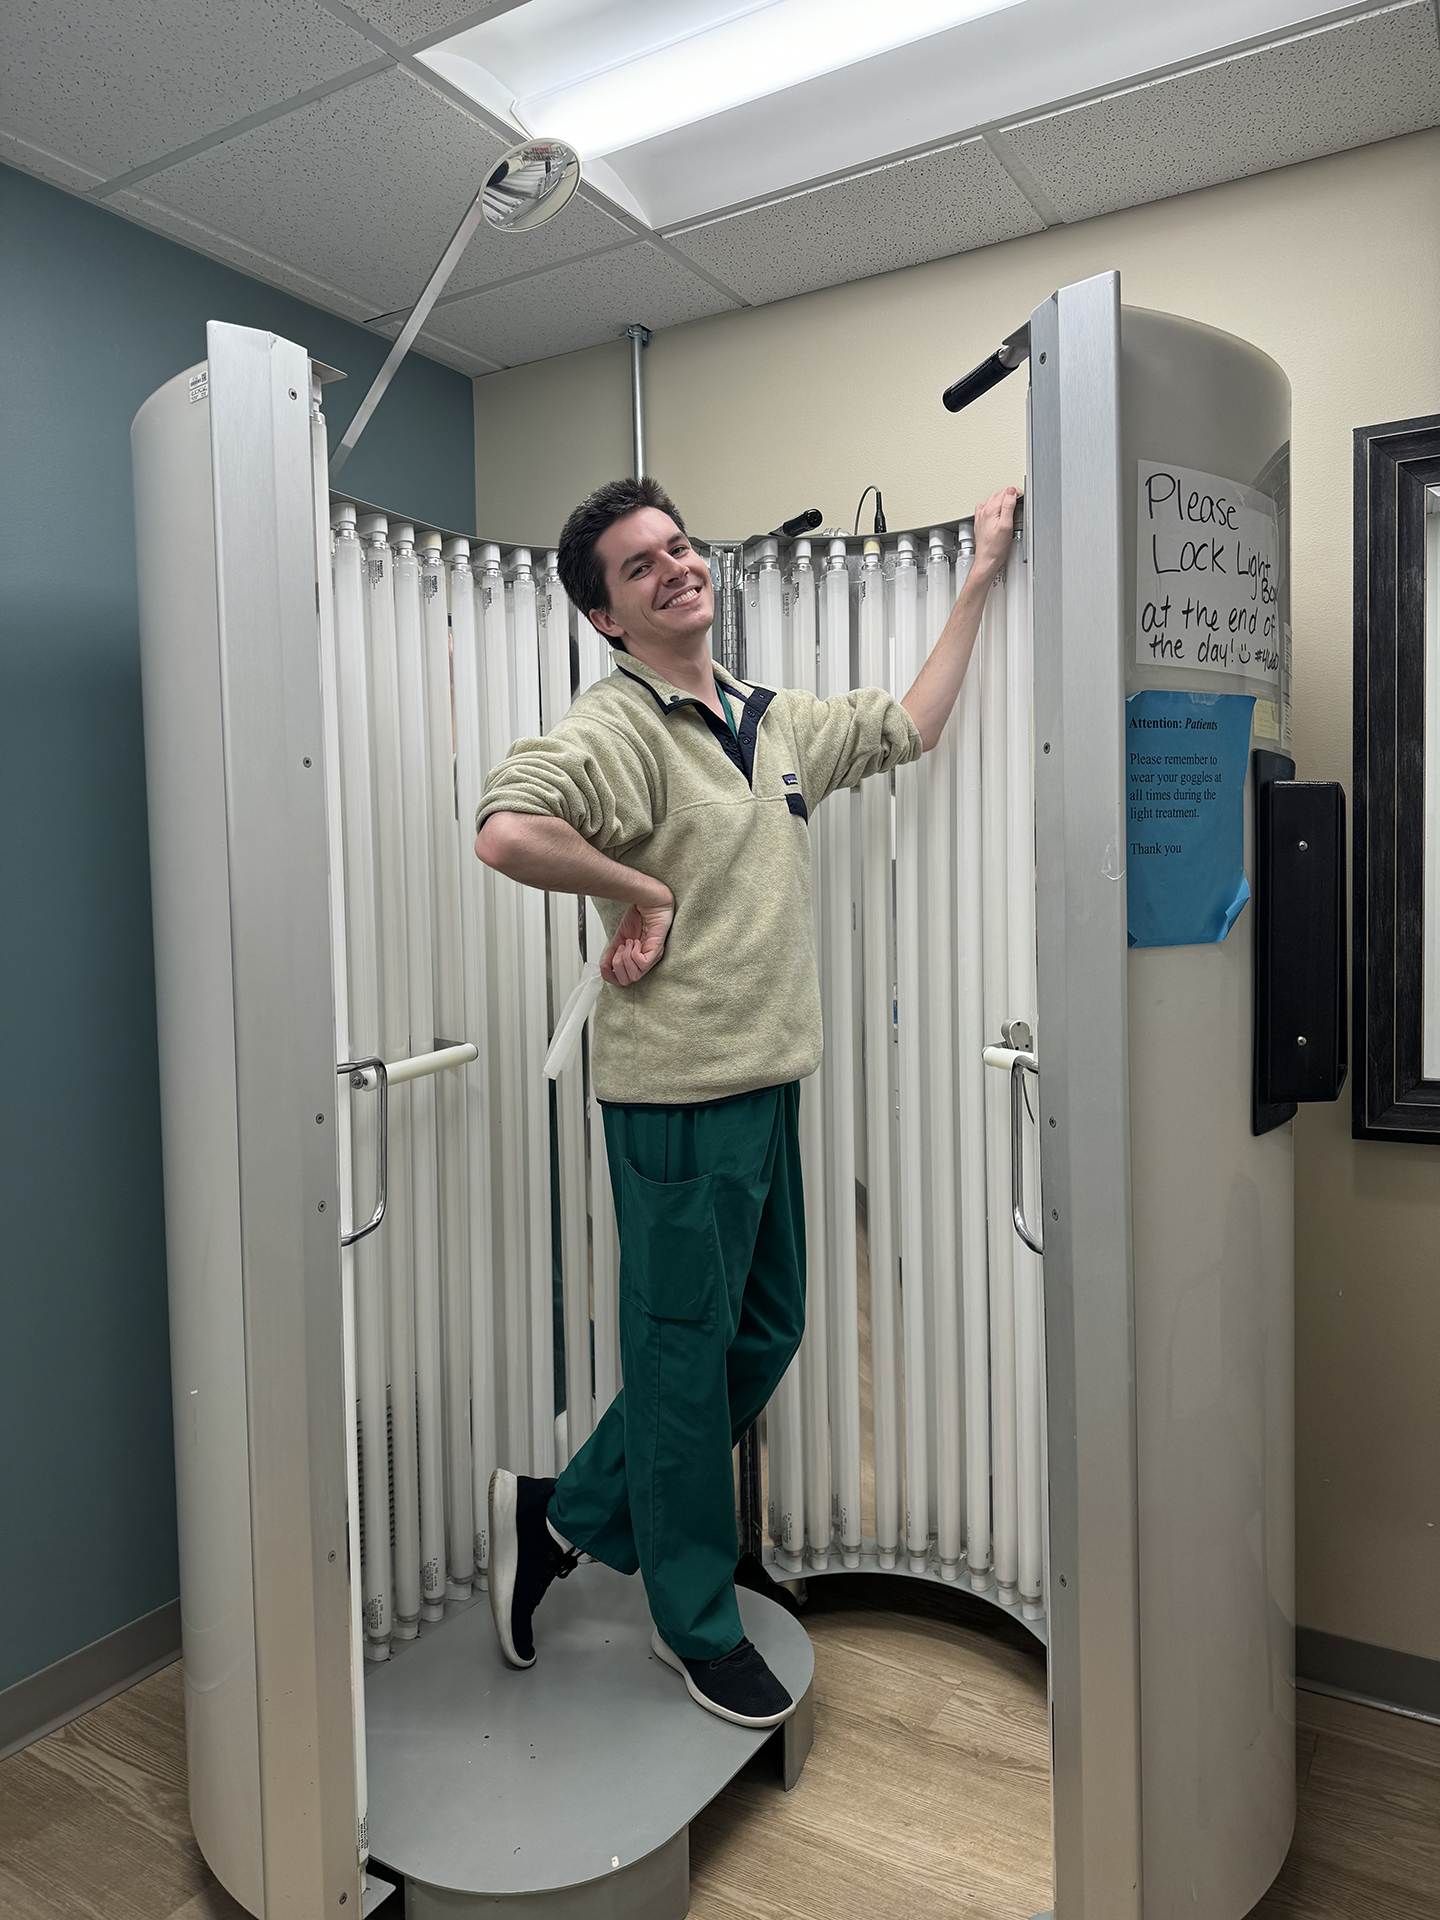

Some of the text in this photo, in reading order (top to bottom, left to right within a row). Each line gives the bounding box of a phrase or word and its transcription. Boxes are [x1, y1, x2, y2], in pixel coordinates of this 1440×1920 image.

[1145, 472, 1239, 530] Please
[1153, 534, 1271, 601] Lock Light
[1141, 595, 1276, 641] at the end of
[1149, 632, 1185, 660] the
[1198, 633, 1234, 668] day!
[1129, 717, 1218, 731] Attention: Patients
[1130, 753, 1218, 766] Please remember to
[1130, 772, 1222, 786] wear your goggles at
[1129, 789, 1216, 803] all times during the
[1130, 807, 1200, 821] light treatment.
[1130, 843, 1182, 856] Thank you
